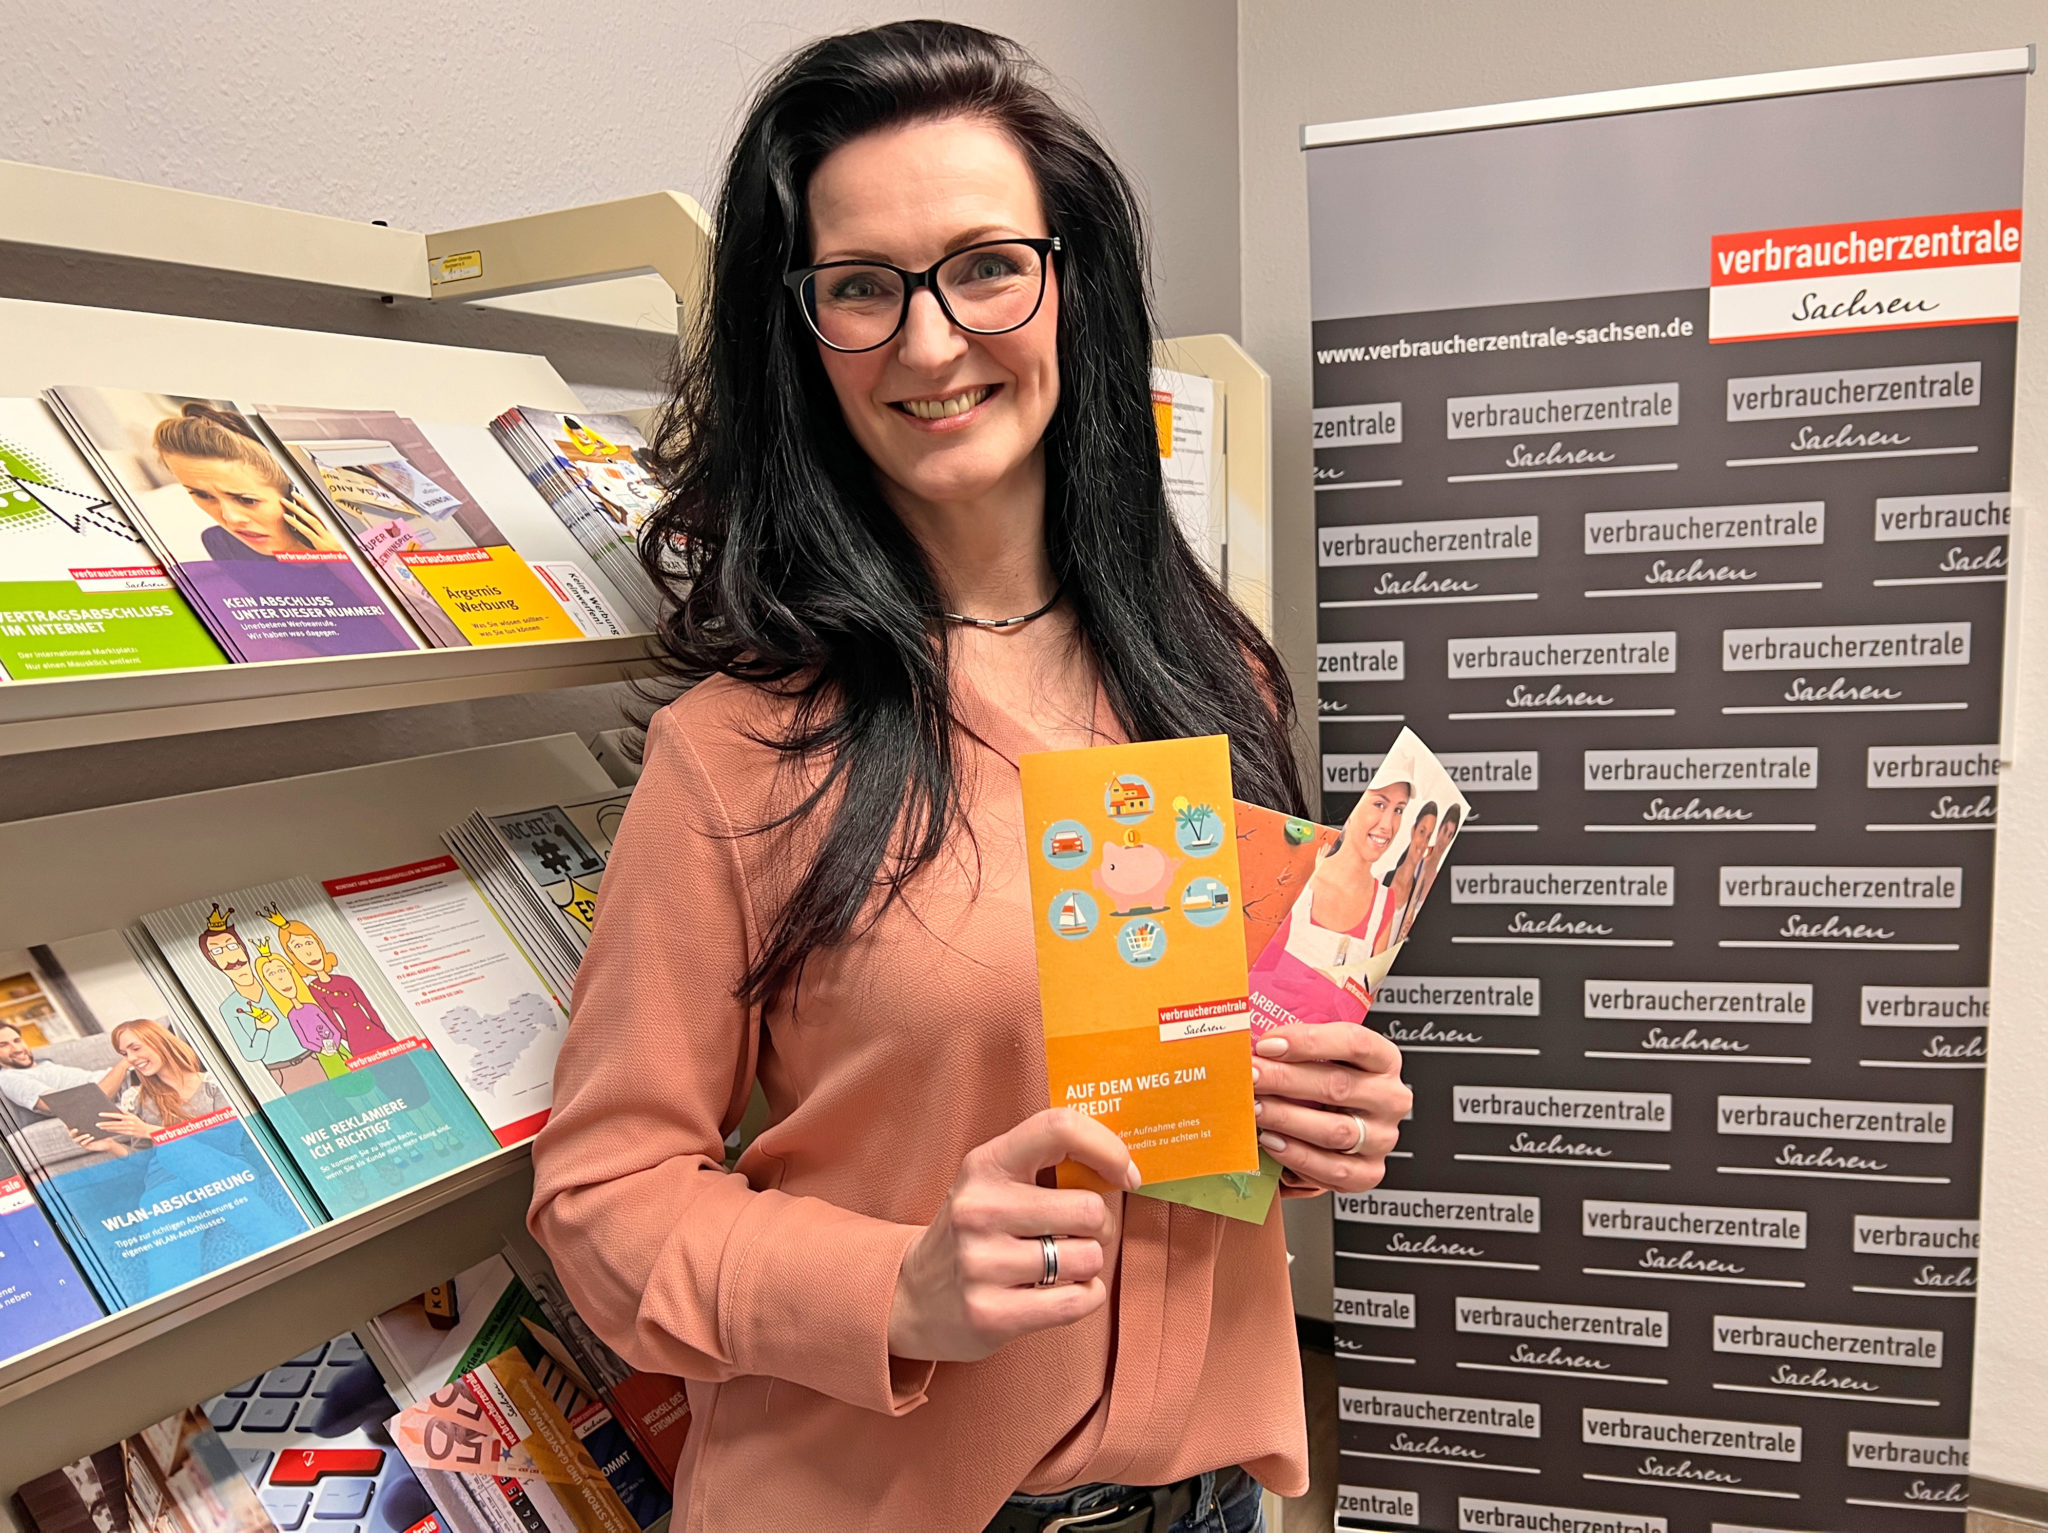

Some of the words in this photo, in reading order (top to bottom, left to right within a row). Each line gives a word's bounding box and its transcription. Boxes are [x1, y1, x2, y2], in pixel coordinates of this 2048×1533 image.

[1718, 221, 2019, 275] verbraucherzentrale
[1791, 289, 1940, 322] Sachsen
[1317, 317, 1693, 364] www.verbraucherzentrale-sachsen.de
[1733, 372, 1974, 412] verbraucherzentrale
[1451, 393, 1673, 430] verbraucherzentrale
[1790, 426, 1911, 451] Sachsen
[1505, 445, 1616, 468] Sachsen
[1589, 510, 1818, 545] verbraucherzentrale
[1322, 525, 1532, 558] verbraucherzentrale
[276, 552, 349, 562] verbraucherzentrale
[402, 550, 490, 565] verbraucherzentrale
[73, 565, 163, 578] verbraucherzentrale
[1373, 572, 1479, 595] Sachsen
[1644, 561, 1757, 585] Sachsen
[223, 596, 258, 608] KEIN
[259, 596, 334, 607] ABSCHLUSS
[443, 585, 502, 600] Ärgernis
[566, 582, 604, 625] einwerfen!
[568, 572, 590, 595] Keine
[589, 596, 620, 636] Werbung
[232, 608, 280, 621] UNTER
[280, 607, 325, 619] DIESER
[326, 605, 385, 617] NUMMER!
[455, 599, 520, 613] Werbung
[0, 625, 26, 636] IM
[26, 622, 106, 636] INTERNET
[264, 631, 288, 639] haben
[1453, 643, 1669, 670] verbraucherzentrale
[1728, 632, 1965, 661] verbraucherzentrale
[1505, 685, 1614, 707] Sachsen
[1783, 677, 1902, 702] Sachsen
[1589, 757, 1811, 782] verbraucherzentrale
[1642, 799, 1752, 821] Sachsen
[1455, 874, 1668, 898] verbraucherzentrale
[1725, 876, 1955, 900] verbraucherzentrale
[1507, 912, 1613, 934] Sachsen
[1780, 916, 1895, 939] Sachsen
[1160, 1000, 1247, 1021] verbraucherzentrale
[1589, 988, 1806, 1015] verbraucherzentrale
[1183, 1023, 1226, 1036] Sachsen
[1384, 1021, 1482, 1043] Sachsen
[1641, 1029, 1749, 1051] Sachsen
[347, 1040, 417, 1070] verbraucherzentrale
[1066, 1082, 1096, 1099] AUF
[1100, 1078, 1133, 1096] DEM
[1136, 1072, 1170, 1091] WEG
[1174, 1066, 1207, 1084] ZUM
[301, 1127, 330, 1147] WIE
[330, 1098, 408, 1136] REKLAMIERE
[1458, 1095, 1665, 1126] verbraucherzentrale
[1722, 1106, 1947, 1136] verbraucherzentrale
[154, 1110, 236, 1143] verbraucherzentrale
[309, 1142, 335, 1160] ICH
[335, 1119, 392, 1149] RICHTIG?
[1133, 1122, 1177, 1136] Aufnahme
[1177, 1118, 1201, 1129] eines
[1159, 1137, 1169, 1146] zu
[1170, 1131, 1199, 1145] achten
[1201, 1128, 1211, 1139] ist
[325, 1169, 344, 1181] wenn
[344, 1162, 356, 1173] Sie
[356, 1158, 367, 1168] als
[366, 1151, 386, 1163] Kunde
[387, 1145, 402, 1156] nicht
[402, 1139, 418, 1150] mehr
[418, 1130, 438, 1144] König
[1509, 1133, 1612, 1157] Sachsen
[1775, 1145, 1887, 1169] Sachsen
[320, 1165, 331, 1174] So
[331, 1154, 359, 1169] kommen
[359, 1147, 371, 1157] Sie
[101, 1169, 256, 1232] WLAN-ABSICHERUNG
[1337, 1193, 1534, 1225] verbraucherzentrale
[115, 1236, 138, 1250] Tipps
[138, 1232, 151, 1242] zur
[151, 1219, 187, 1237] richtigen
[186, 1202, 235, 1226] Absicherung
[234, 1195, 249, 1207] des
[1587, 1208, 1800, 1241] verbraucherzentrale
[121, 1242, 154, 1259] eigenen
[153, 1215, 226, 1248] WLAN-Anschlusses
[1386, 1234, 1484, 1257] Sachsen
[1638, 1249, 1745, 1273] Sachsen
[1461, 1305, 1662, 1339] verbraucherzentrale
[1718, 1324, 1936, 1360] verbraucherzentrale
[1509, 1345, 1610, 1369] Sachsen
[1770, 1366, 1879, 1392] Sachsen
[465, 1372, 517, 1446] verbraucherzentrale
[494, 1382, 518, 1418] Sachsen
[641, 1402, 672, 1425] WECHSEL
[669, 1391, 685, 1406] DES
[1342, 1394, 1535, 1431] verbraucherzentrale
[528, 1407, 569, 1465] GASVERTRAG
[1389, 1435, 1485, 1459] Sachsen
[1587, 1416, 1795, 1454] verbraucherzentrale
[567, 1464, 583, 1486] UND
[1638, 1458, 1741, 1485] Sachsen
